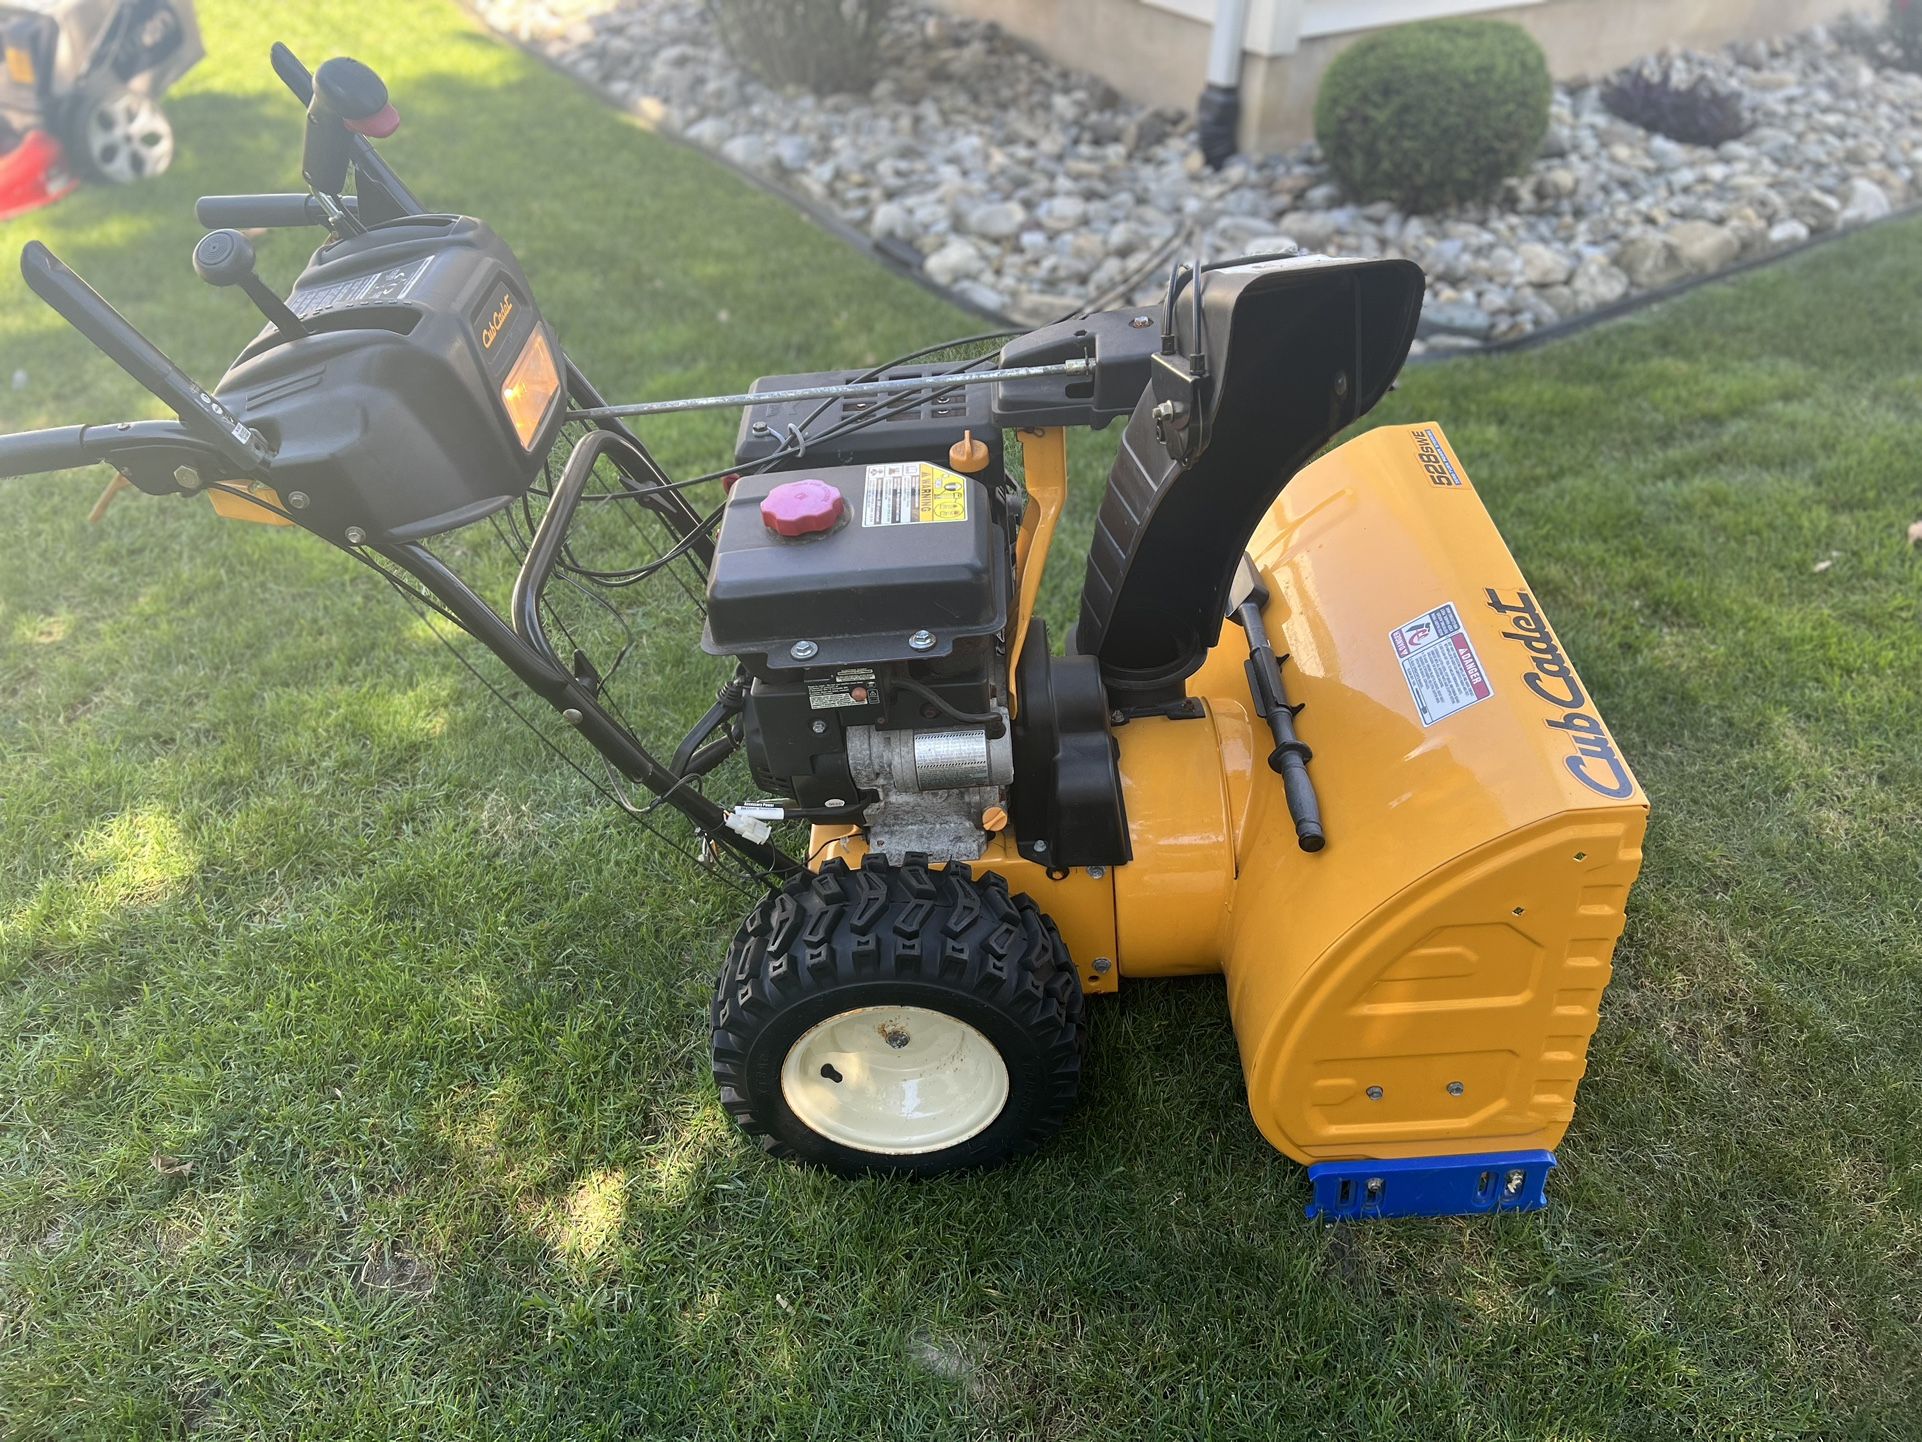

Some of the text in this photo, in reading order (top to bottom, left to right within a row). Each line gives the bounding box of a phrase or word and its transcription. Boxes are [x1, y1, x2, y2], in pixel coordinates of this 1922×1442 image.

[482, 293, 513, 349] Cub Cadet
[920, 479, 932, 513] WARNING
[1461, 652, 1483, 686] DANGER
[1485, 587, 1633, 799] Cub Cadet
